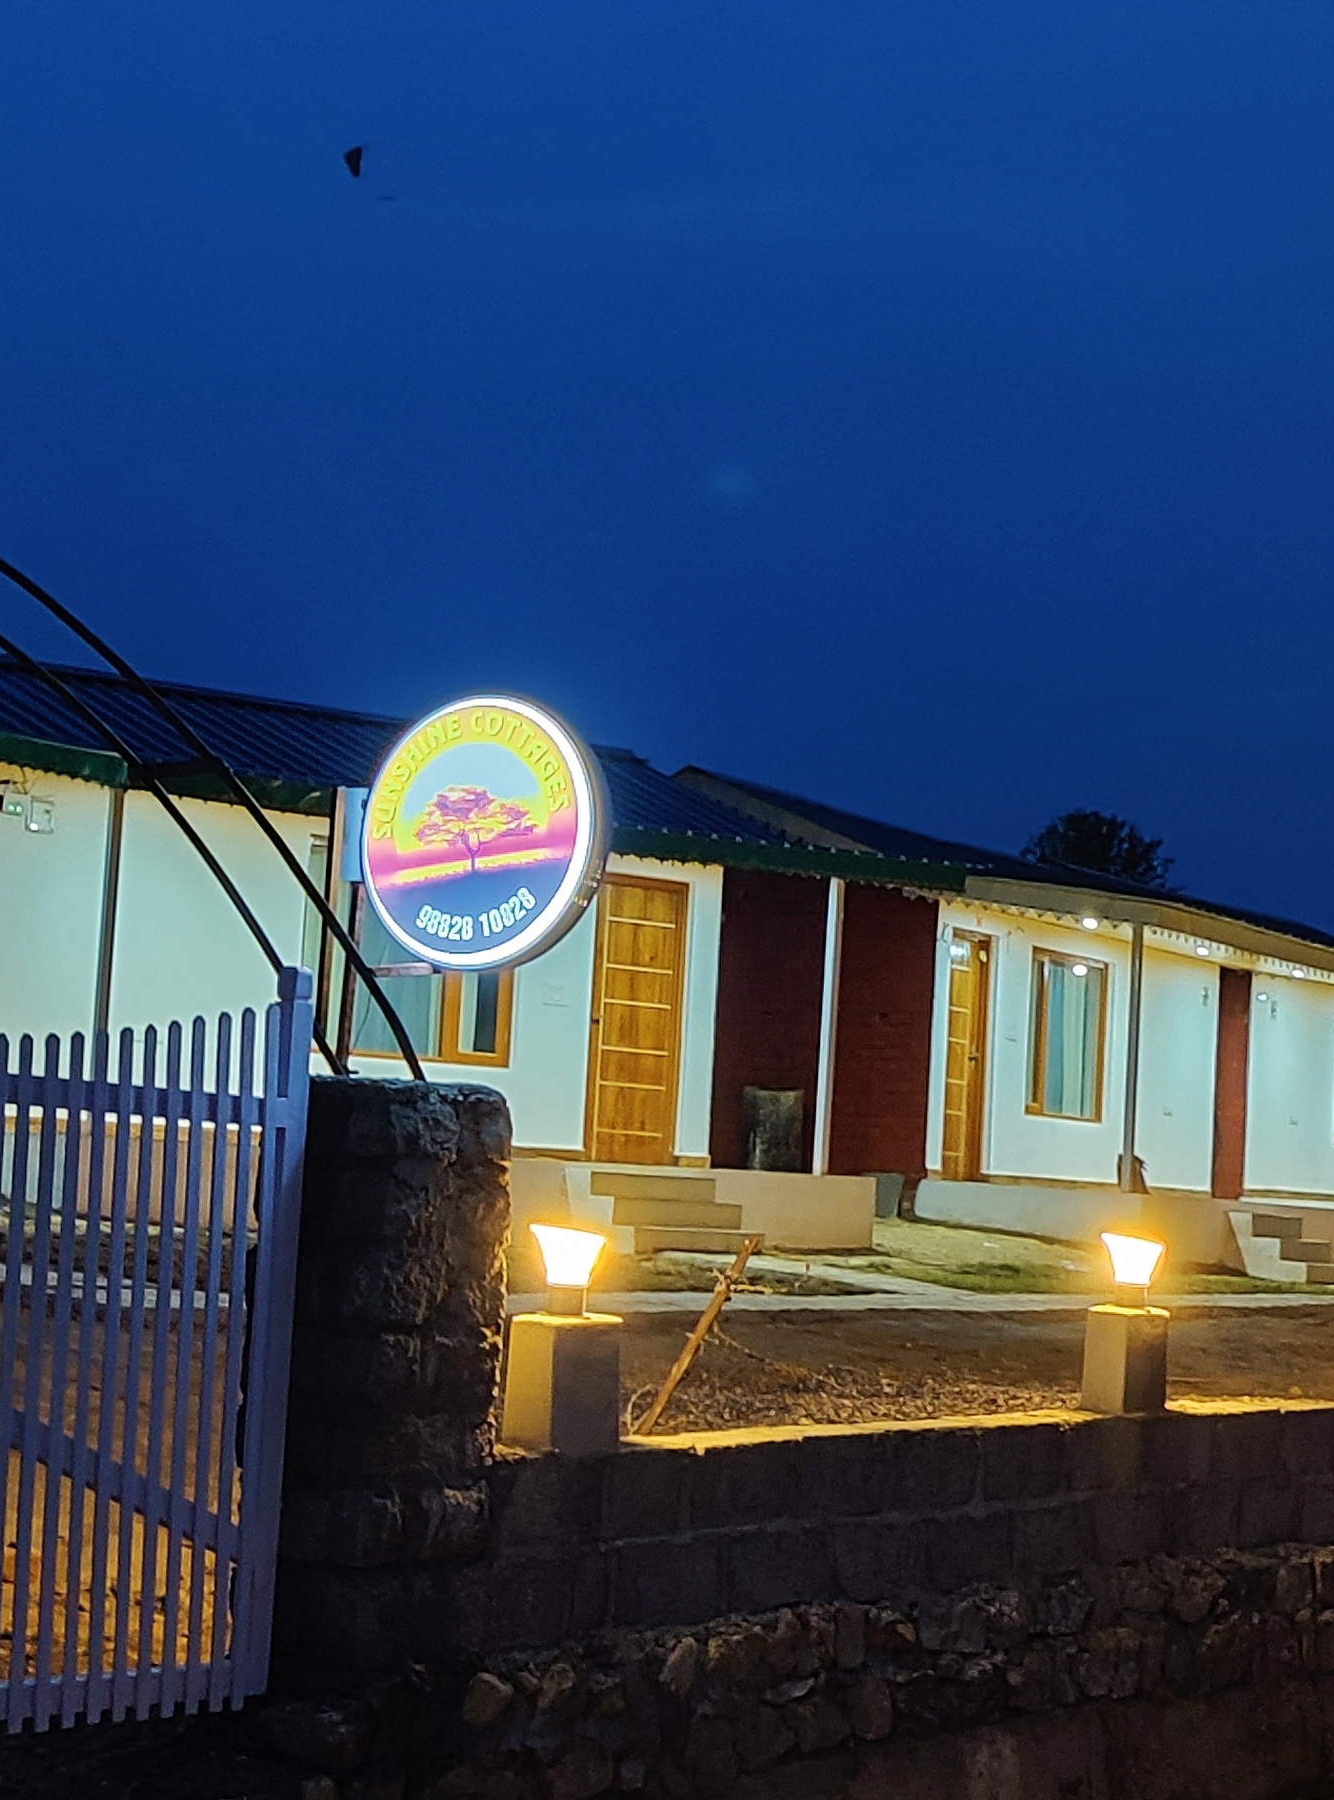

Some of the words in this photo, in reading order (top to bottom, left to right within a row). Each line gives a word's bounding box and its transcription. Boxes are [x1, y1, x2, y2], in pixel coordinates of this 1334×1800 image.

[372, 715, 462, 840] SUNSHINE
[471, 710, 569, 813] COTTAGES
[416, 904, 474, 941] 98828
[478, 886, 536, 937] 10828
